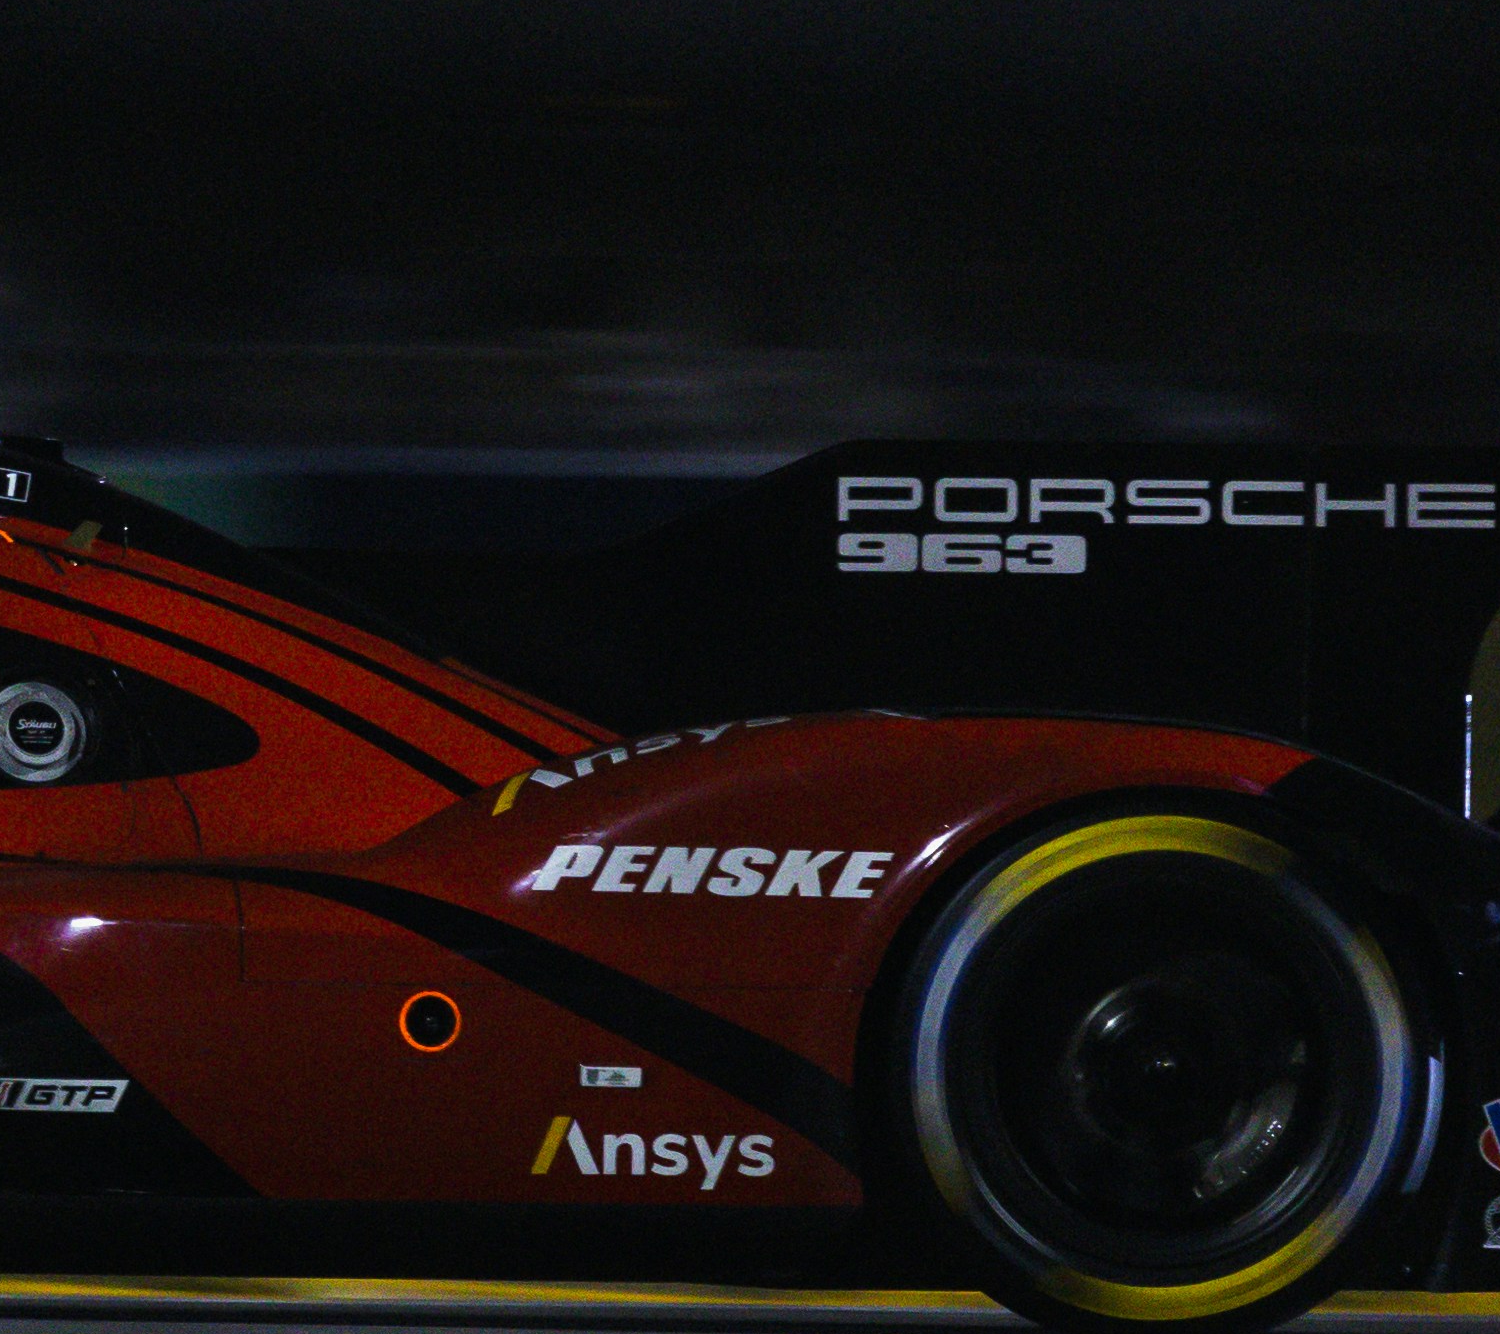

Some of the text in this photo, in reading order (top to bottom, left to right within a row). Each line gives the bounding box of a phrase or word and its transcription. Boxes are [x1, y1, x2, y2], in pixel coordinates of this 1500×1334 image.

[837, 476, 1496, 529] PORSCHE
[837, 533, 1087, 574] 963
[532, 844, 896, 899] PENSKE
[24, 1084, 118, 1107] GTP
[531, 1115, 776, 1190] Ansys
